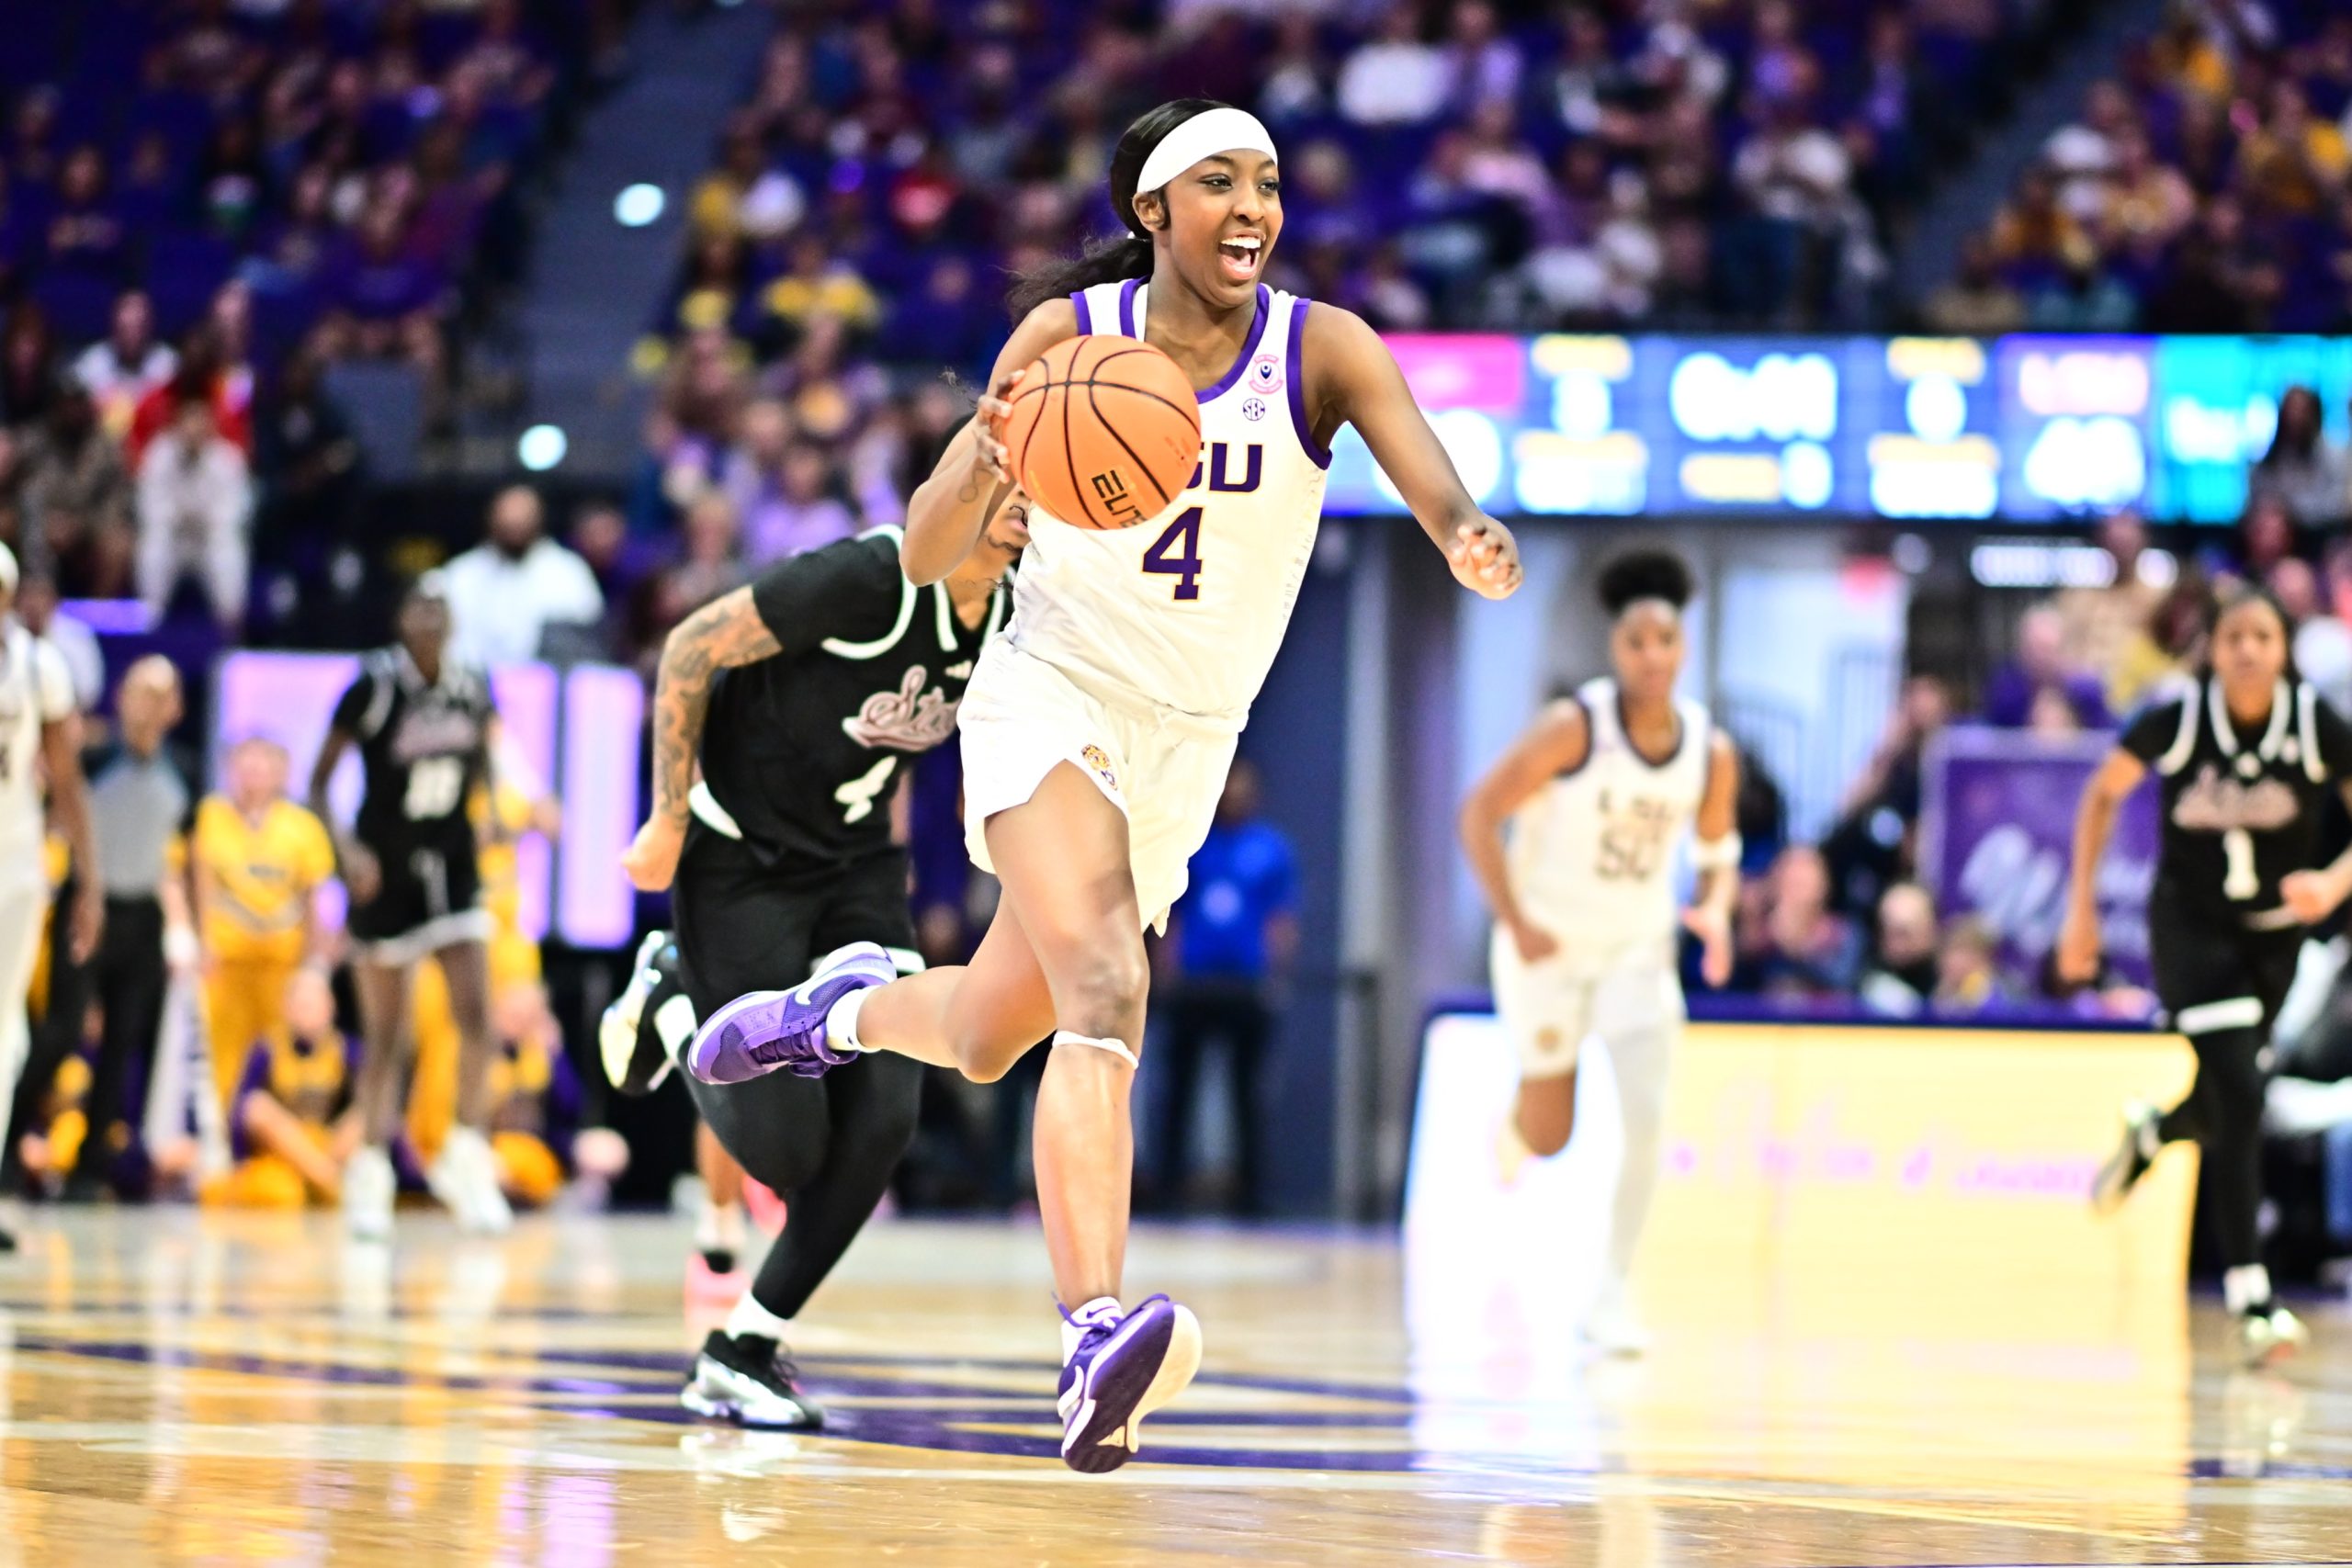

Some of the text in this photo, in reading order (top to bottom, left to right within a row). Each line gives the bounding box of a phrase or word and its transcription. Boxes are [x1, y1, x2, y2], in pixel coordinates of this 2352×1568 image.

[1243, 398, 1265, 422] SEC
[1142, 506, 1204, 601] 4
[834, 754, 898, 825] 4
[2222, 829, 2260, 900] 1
